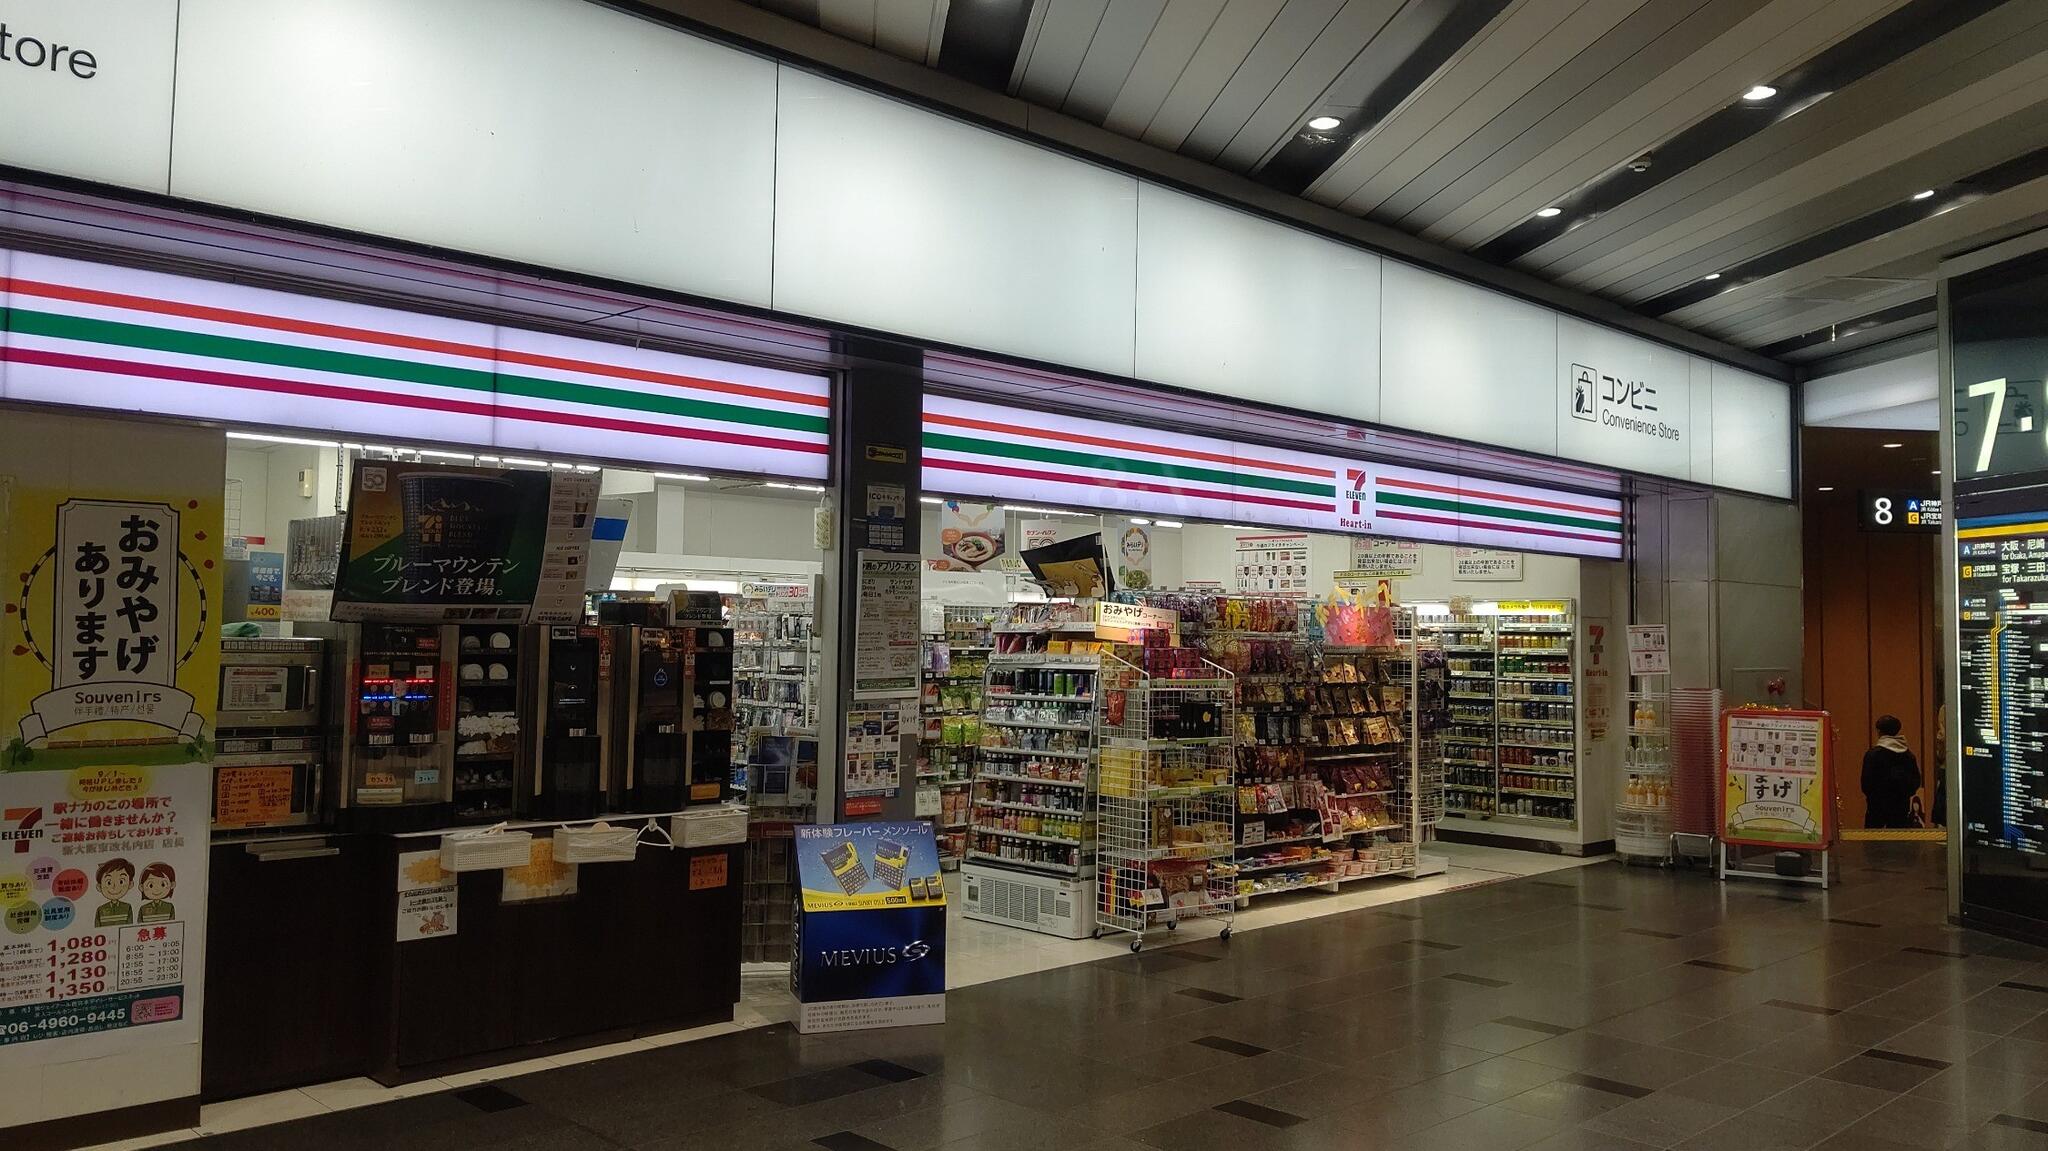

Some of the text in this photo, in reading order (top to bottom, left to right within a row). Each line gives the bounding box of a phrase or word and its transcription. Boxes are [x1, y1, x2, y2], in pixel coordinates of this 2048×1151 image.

[1602, 375, 1658, 411] コンビニ
[1602, 409, 1680, 441] Convenience Store
[1874, 497, 1893, 524] 8
[1909, 501, 1918, 510] A
[1340, 518, 1372, 530] Heart-in
[1910, 514, 1918, 523] G
[1964, 545, 1970, 554] A
[374, 554, 520, 574] ブルーマウンテン
[382, 577, 504, 597] ブレンド登場。
[2002, 576, 2012, 584] for
[116, 514, 160, 674] おみやげ
[73, 541, 110, 680] あります
[75, 690, 162, 704] Souvenirs
[54, 797, 172, 814] 駅ナカのこの場所で
[1755, 804, 1796, 813] Souvenirs
[800, 826, 928, 839] 新体験フレーバー メンソール
[807, 901, 832, 909] MEVIUS
[137, 926, 168, 942] 急募
[47, 934, 106, 953] 1,080
[126, 944, 144, 952] 6:00
[162, 940, 180, 948] 9:05
[46, 949, 107, 968] 1,280
[126, 952, 144, 960] 8:55
[158, 948, 180, 957] 13:00
[820, 946, 896, 968] MEVIUS
[120, 961, 144, 969] 12:55
[158, 956, 180, 964] 17:00
[120, 968, 144, 977] 16:55
[156, 964, 179, 972] 21:00
[46, 965, 106, 984] 1,130
[120, 976, 143, 986] 20:55
[156, 972, 178, 980] 23:30
[46, 980, 106, 1000] 1,350
[8, 1008, 126, 1034] 06-4960-9445
